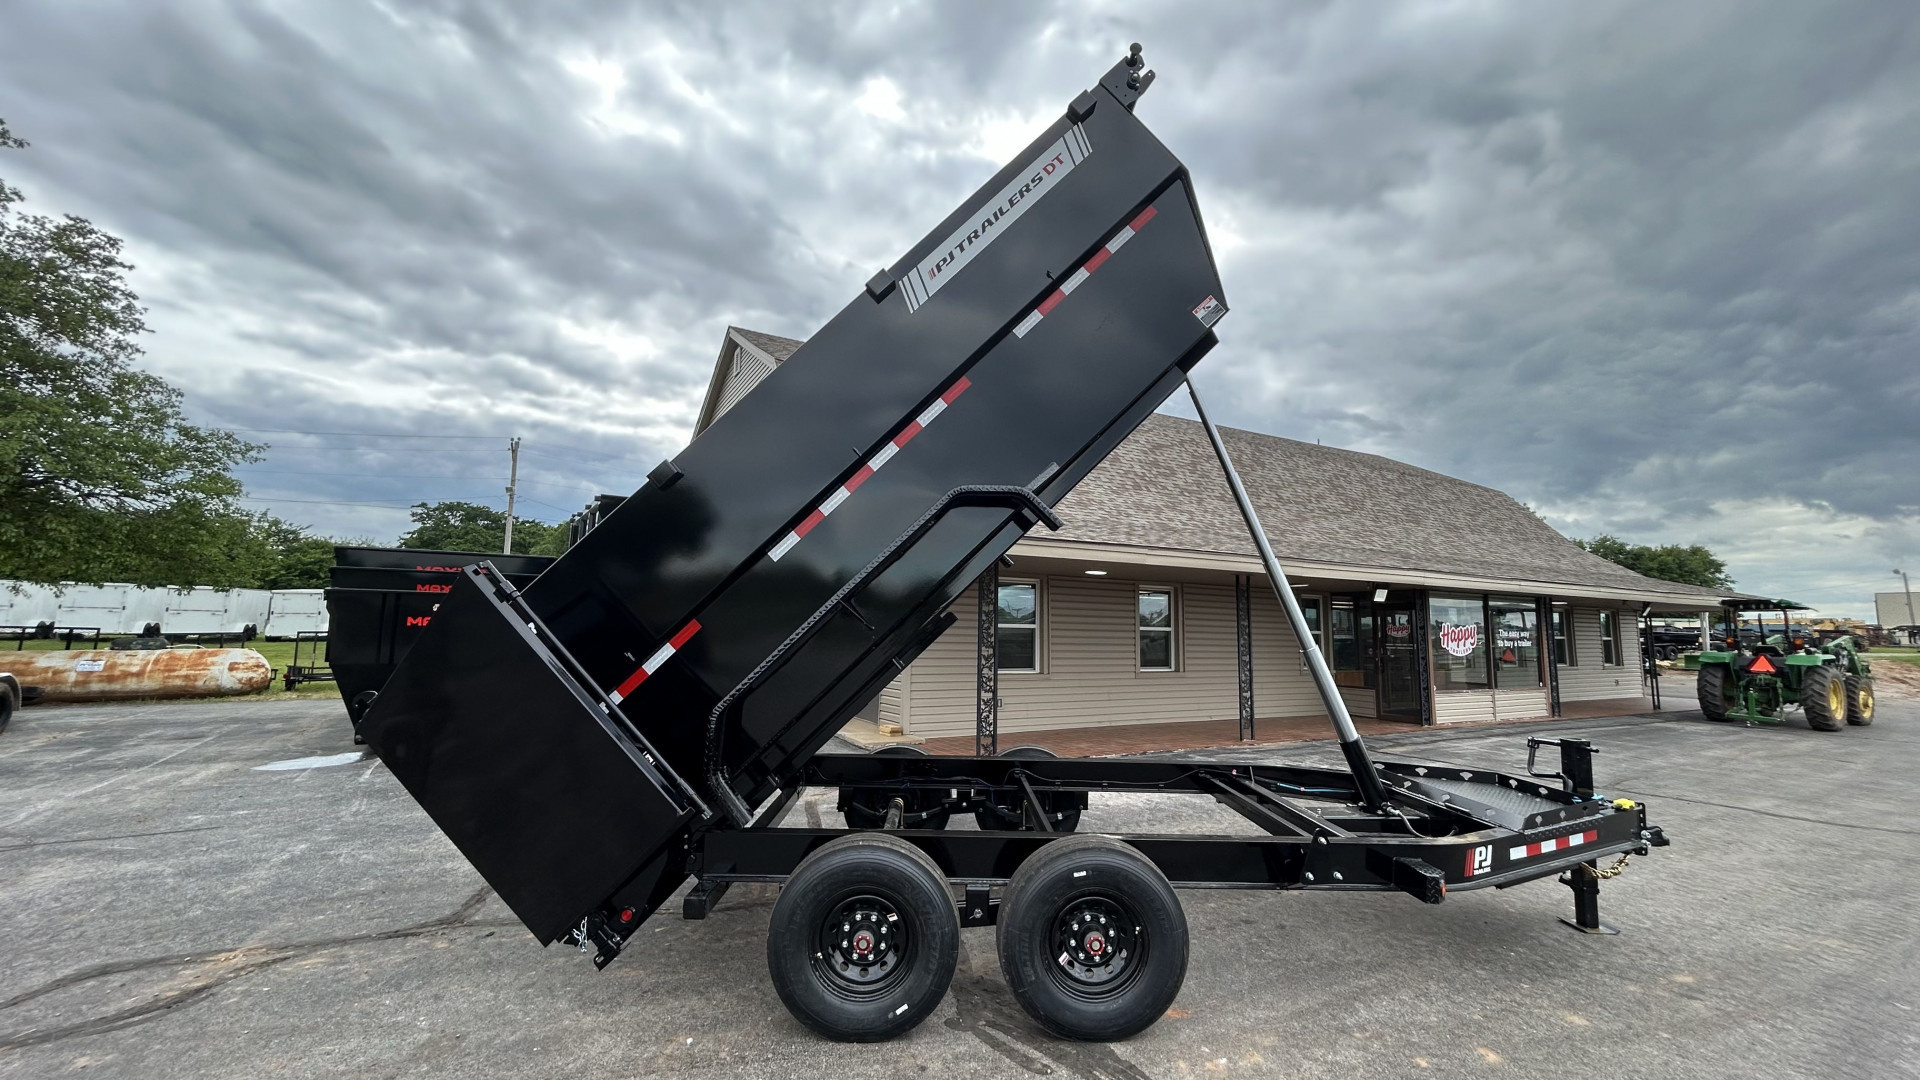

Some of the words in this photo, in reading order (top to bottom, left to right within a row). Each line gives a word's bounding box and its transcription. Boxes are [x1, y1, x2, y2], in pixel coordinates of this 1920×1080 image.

[935, 250, 956, 274] PJ
[954, 172, 1044, 254] TRAILERS
[1042, 152, 1065, 176] DT
[1387, 624, 1410, 635] Happy
[1440, 623, 1477, 649] Happy
[1499, 629, 1509, 637] The
[1509, 631, 1520, 639] easy
[1520, 631, 1530, 639] way
[1504, 639, 1514, 649] buy
[1518, 638, 1533, 647] trailer
[1474, 844, 1493, 870] PJ
